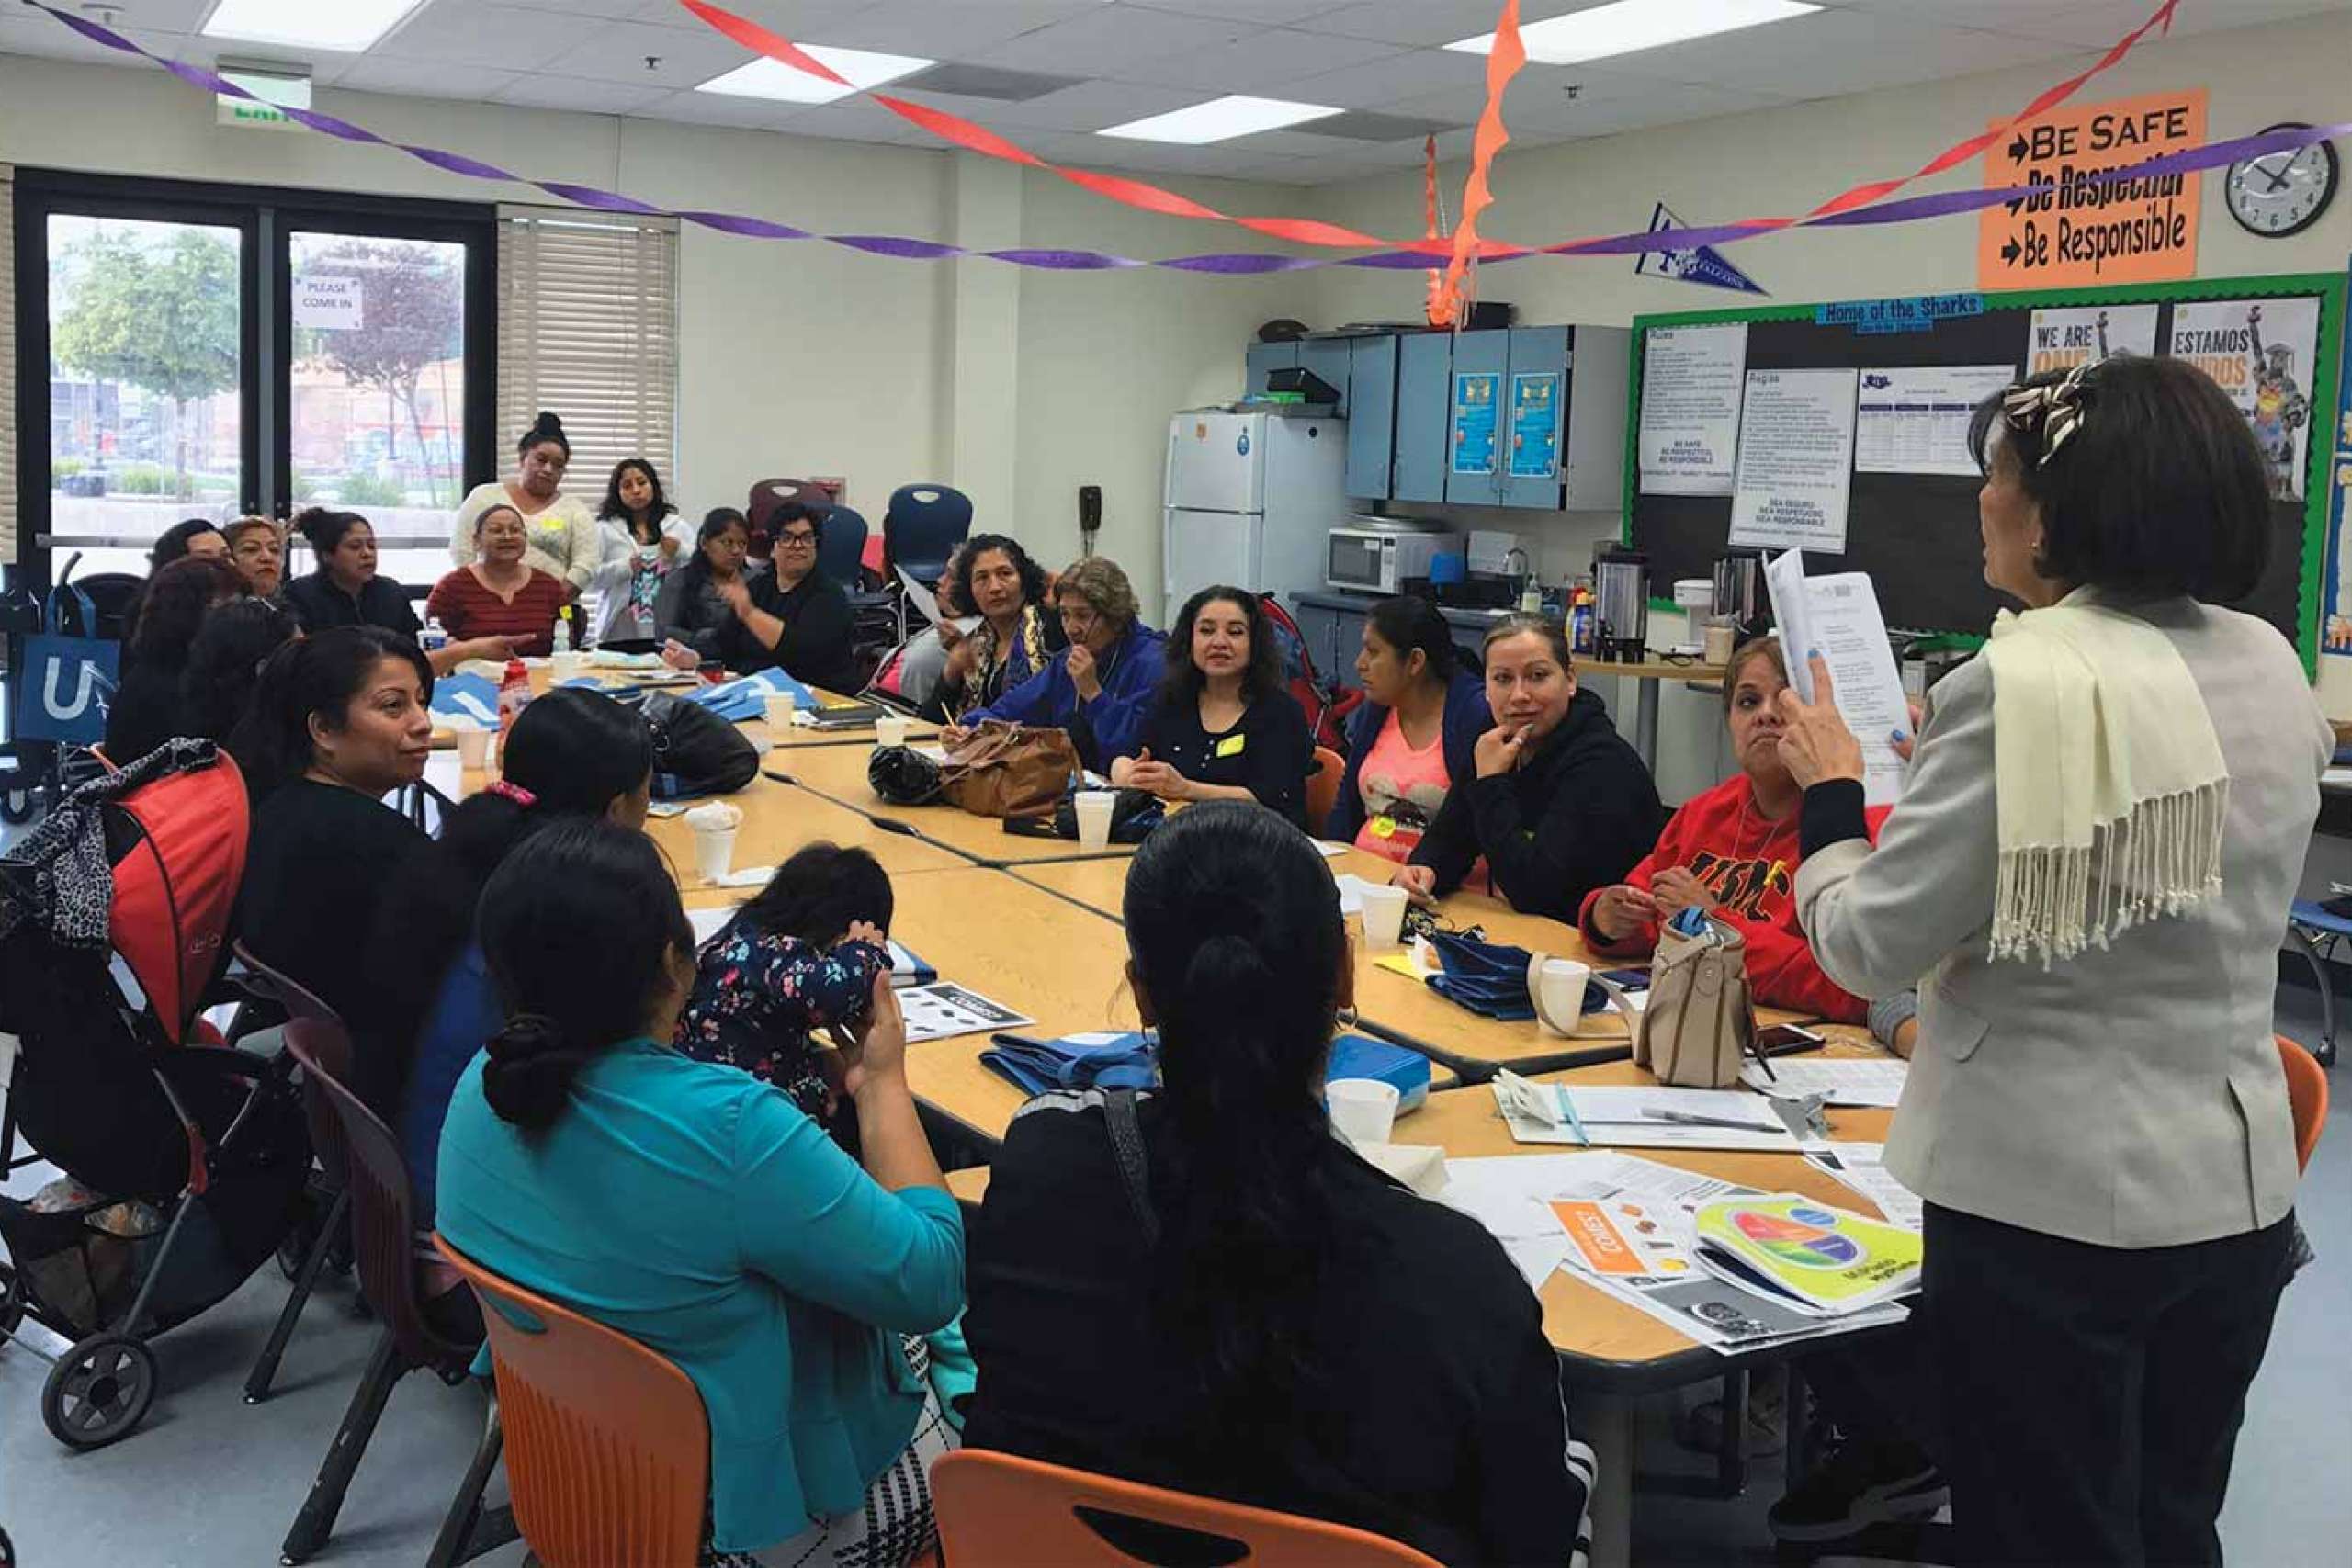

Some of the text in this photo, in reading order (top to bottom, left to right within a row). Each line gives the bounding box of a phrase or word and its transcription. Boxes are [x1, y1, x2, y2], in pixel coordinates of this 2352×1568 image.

[2030, 105, 2188, 161] BE SAFE
[2024, 199, 2187, 275] Be Responsible
[307, 282, 346, 294] PLEASE
[301, 298, 353, 310] COME IN
[1826, 293, 1978, 322] Home of the Sharks
[2037, 324, 2093, 348] WE ARE
[2175, 328, 2249, 354] ESTAMOS
[43, 656, 95, 720] U
